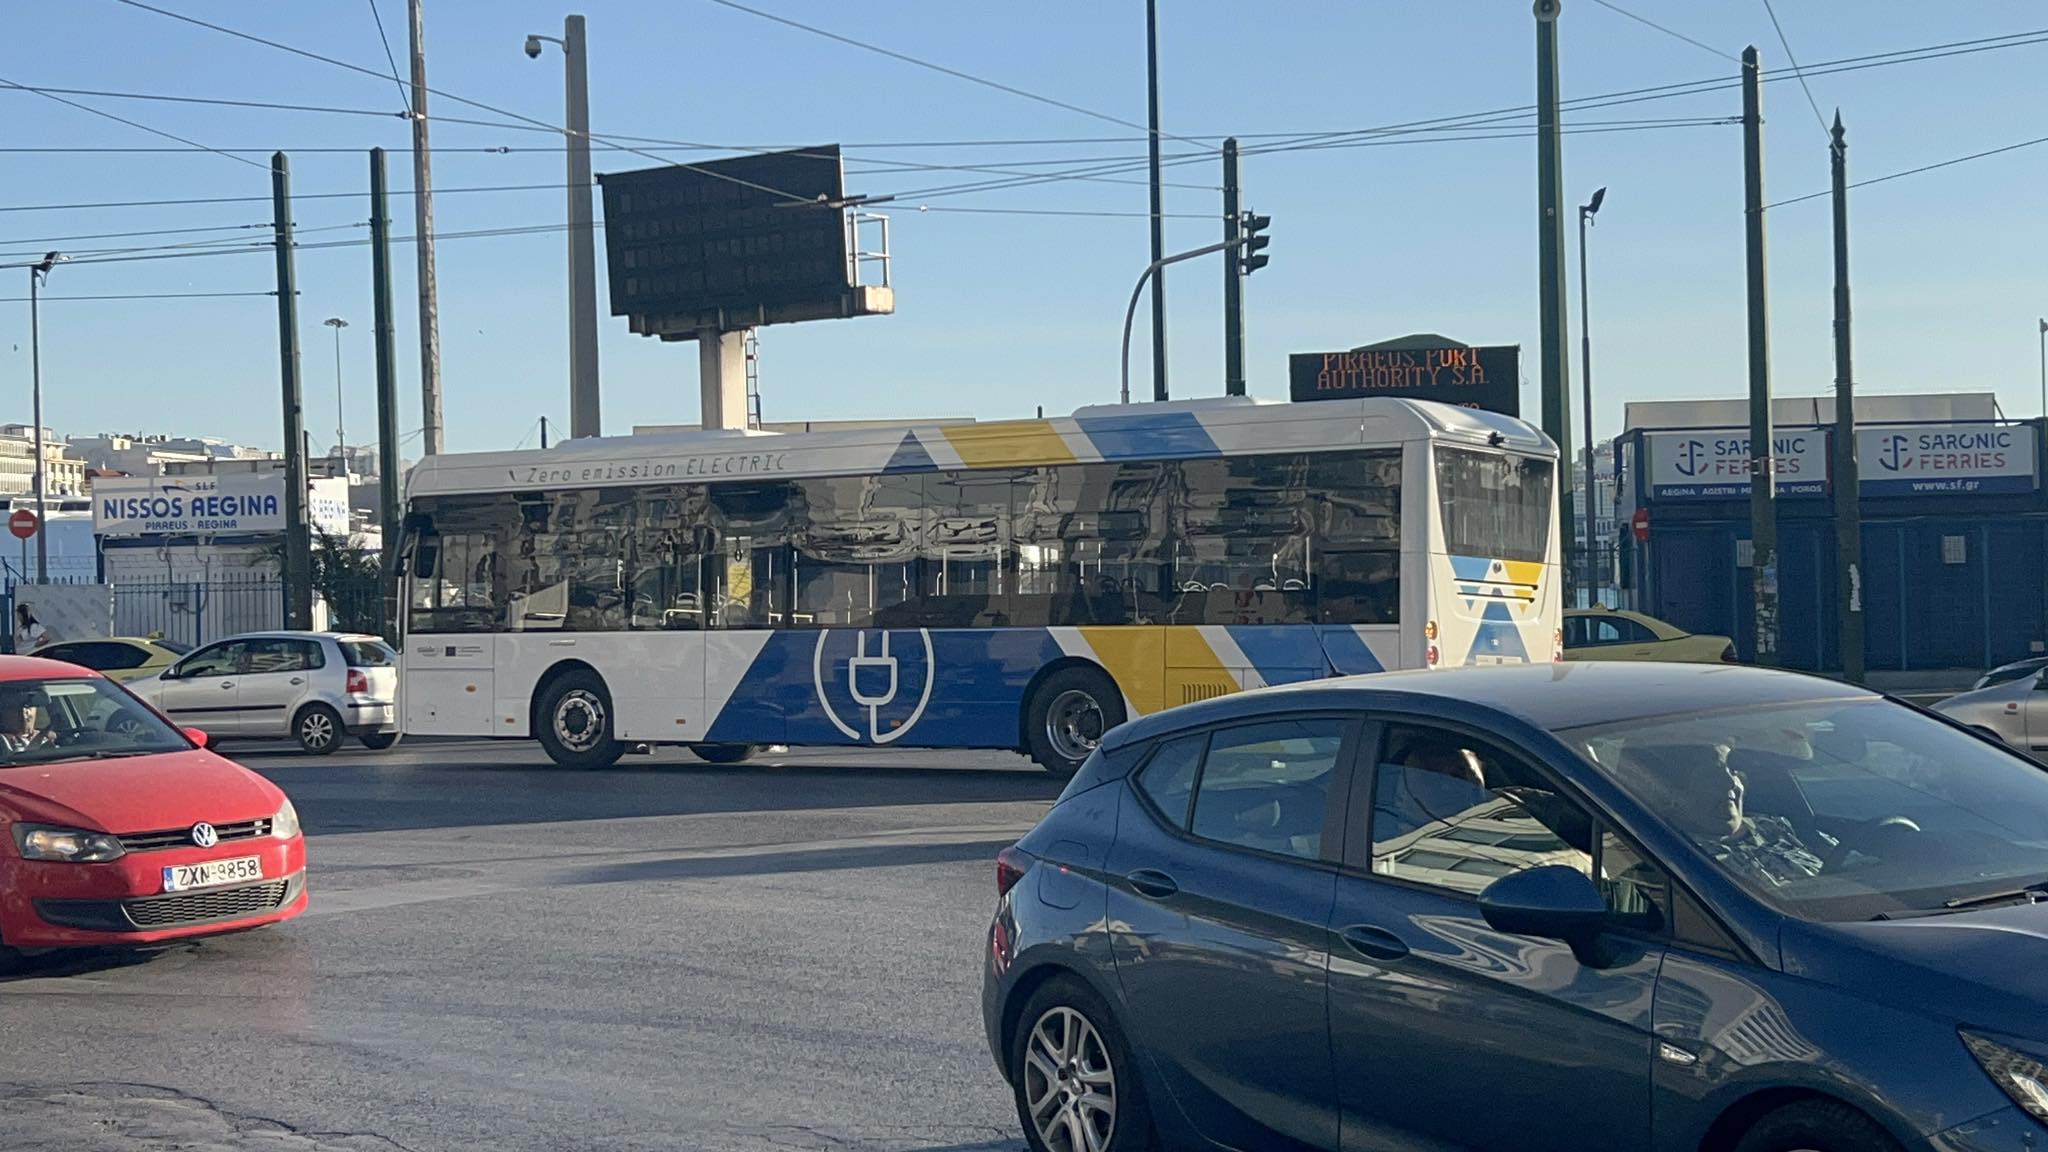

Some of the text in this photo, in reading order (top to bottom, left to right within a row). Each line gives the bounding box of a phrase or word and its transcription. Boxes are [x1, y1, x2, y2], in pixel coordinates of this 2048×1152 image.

[1317, 367, 1440, 390] AUTHORITY
[1714, 438, 1806, 456] SARNIC
[1919, 432, 2011, 450] SARONIC
[526, 453, 787, 483] Zero emission ELECTRIC
[1715, 458, 1801, 475] FERES
[1920, 453, 2006, 470] FERRIES
[1661, 487, 1696, 497] AEGINA
[1912, 480, 1980, 491] www.sf.gr
[103, 495, 278, 519] NISSOS AEGINA
[145, 520, 188, 530] PIRAEUS
[197, 519, 238, 529] AEGINA
